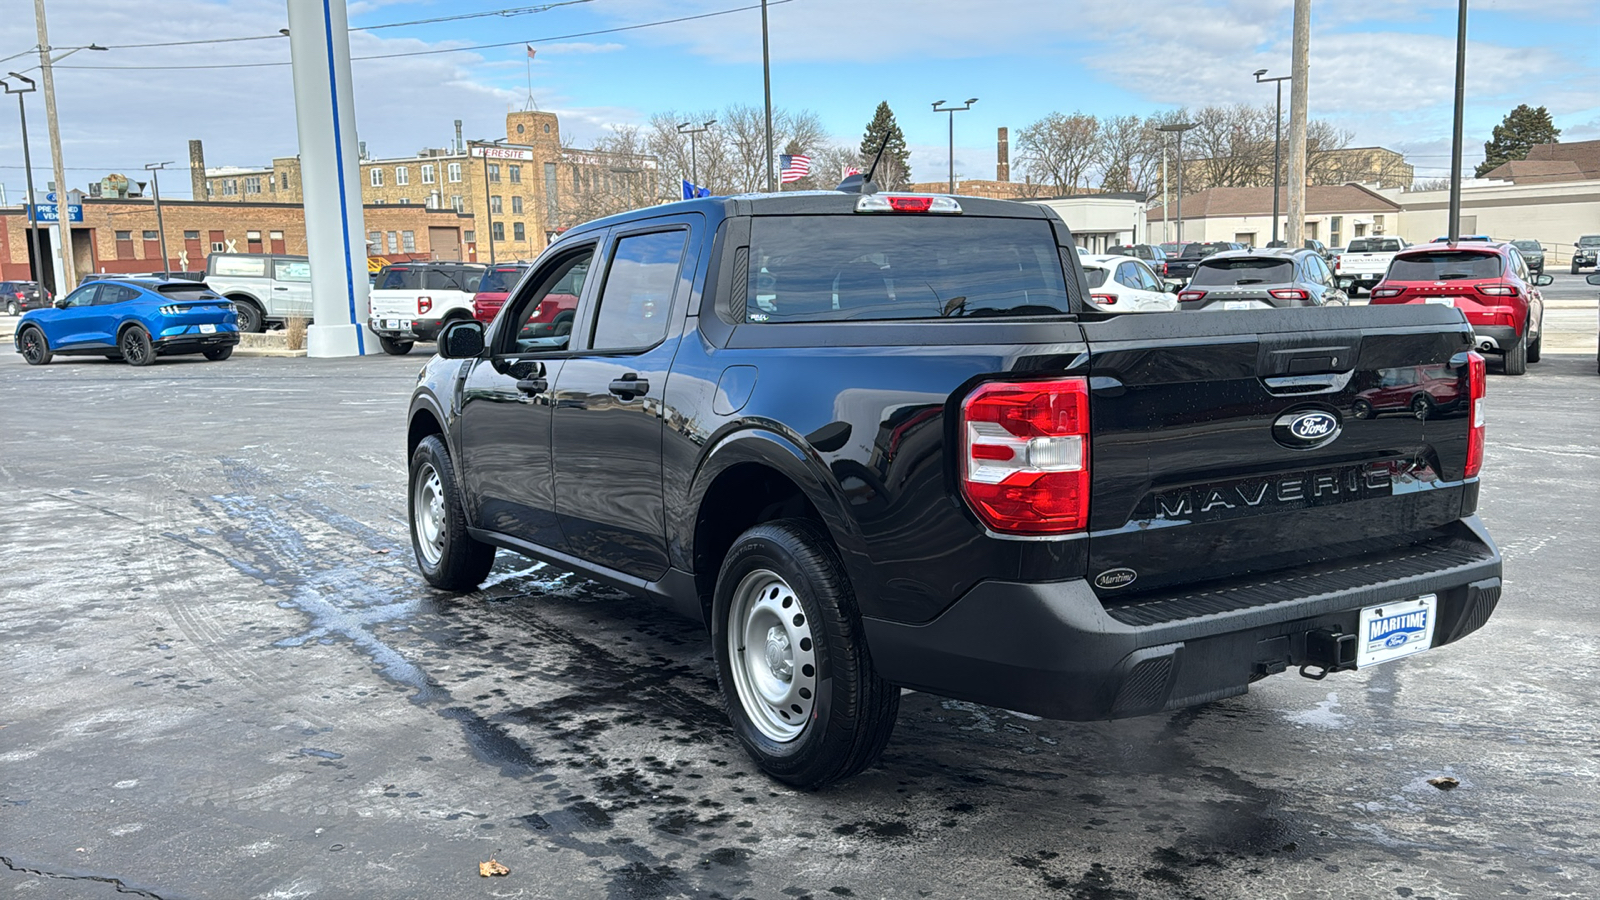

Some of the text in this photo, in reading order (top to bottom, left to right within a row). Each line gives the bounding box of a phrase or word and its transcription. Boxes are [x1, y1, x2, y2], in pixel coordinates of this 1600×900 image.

[478, 148, 525, 158] HERESITE
[37, 205, 79, 213] PRE-ONED
[1300, 417, 1328, 435] Ford
[1155, 461, 1421, 518] MAVERICK
[1100, 572, 1133, 585] Maritime
[1370, 611, 1426, 640] MARITIME
